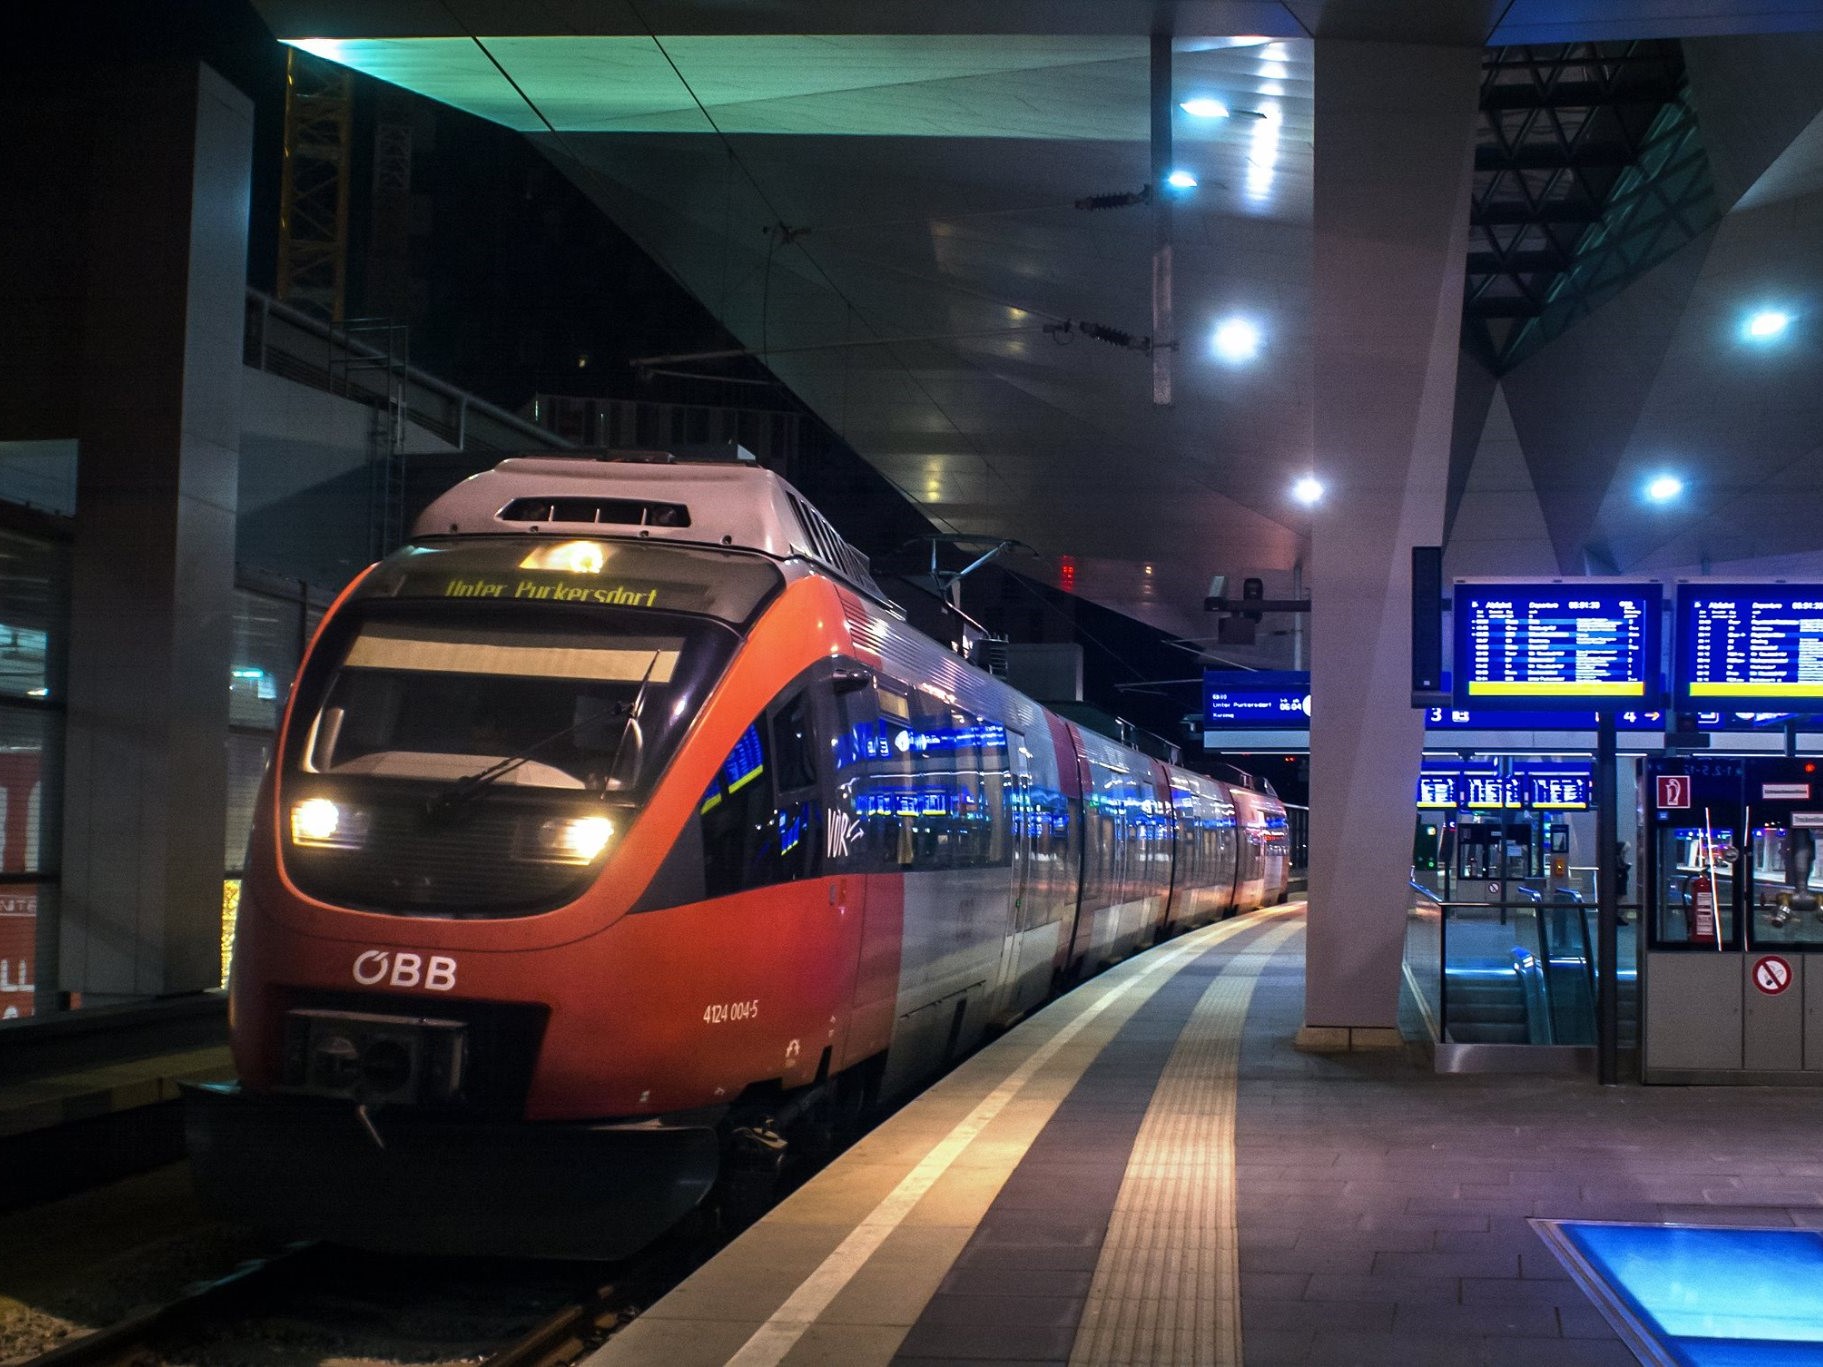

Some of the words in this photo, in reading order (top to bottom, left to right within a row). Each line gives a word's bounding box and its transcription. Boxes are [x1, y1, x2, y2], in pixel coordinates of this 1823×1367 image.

[445, 580, 508, 597] Unter
[827, 807, 849, 859] VOR
[352, 949, 458, 992] ÖBB
